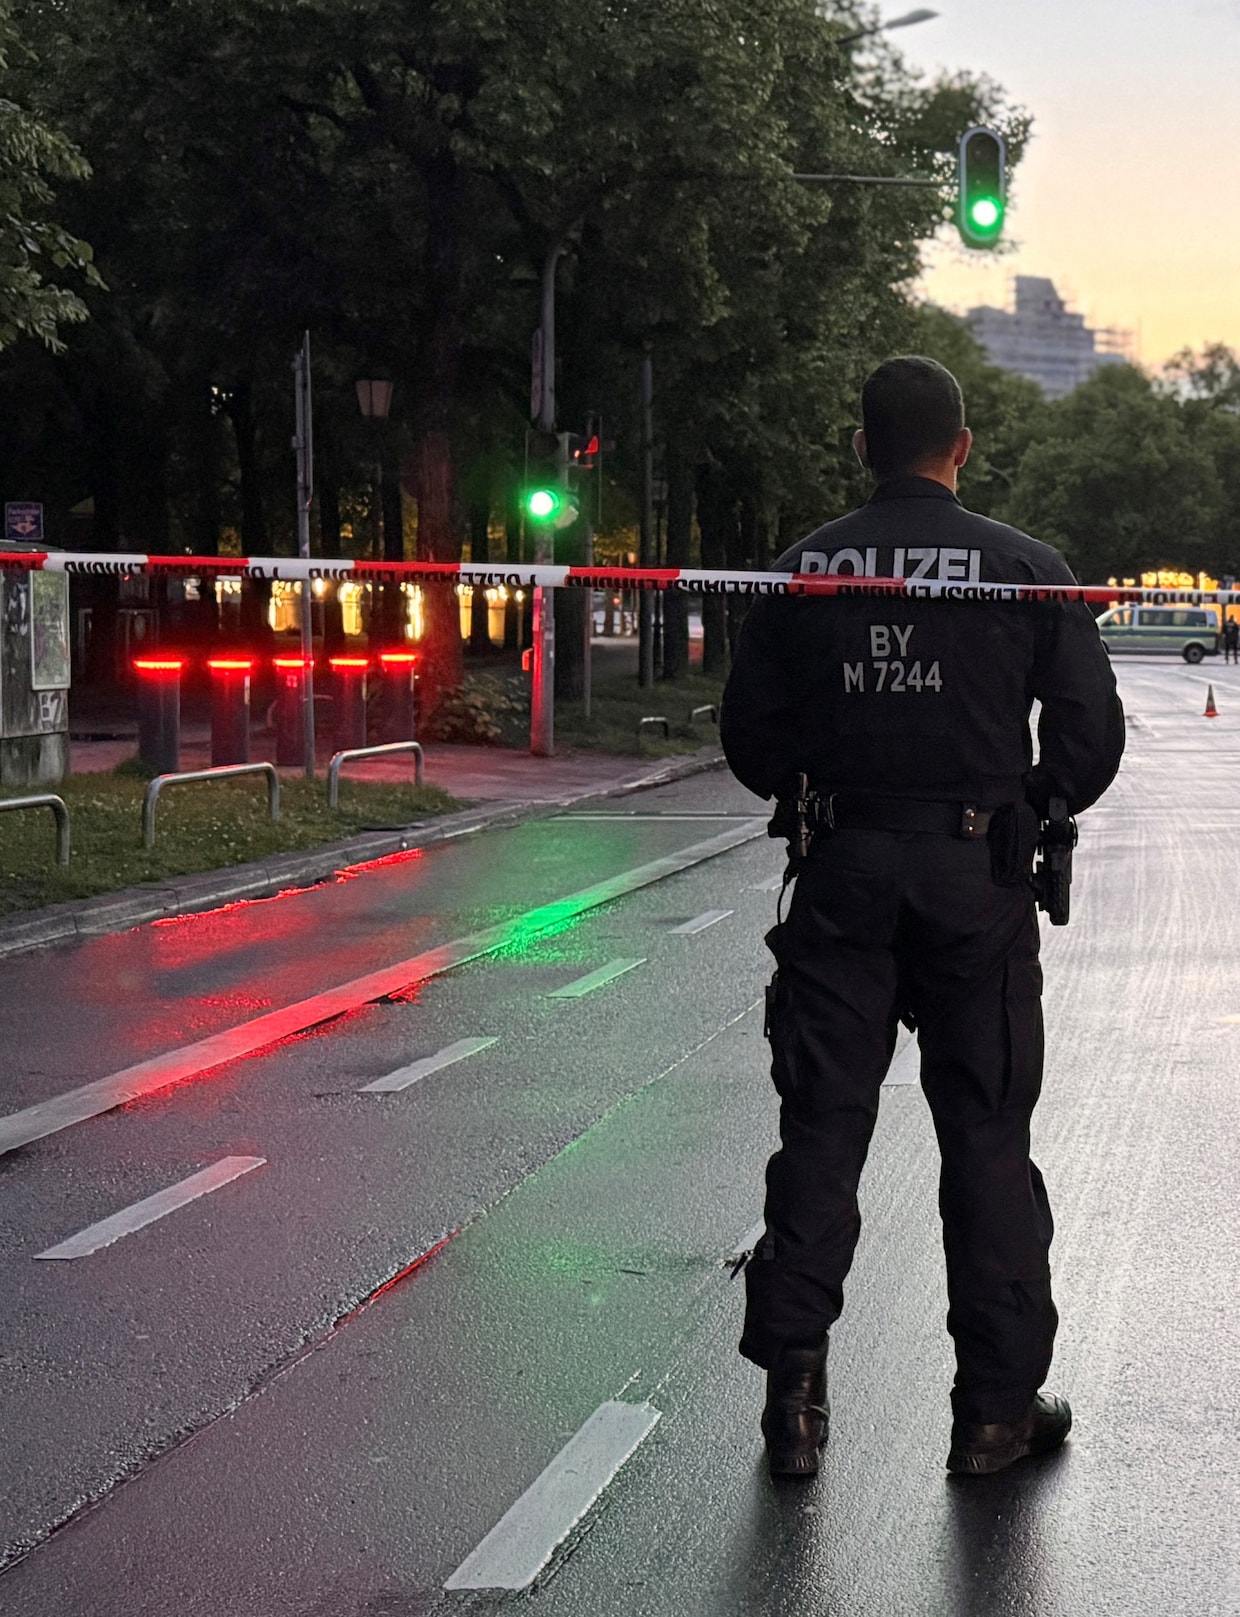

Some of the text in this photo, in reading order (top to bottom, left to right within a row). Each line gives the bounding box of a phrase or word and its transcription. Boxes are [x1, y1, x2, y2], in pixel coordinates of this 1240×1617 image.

[870, 625, 914, 657] BY
[843, 661, 942, 692] M 7244
